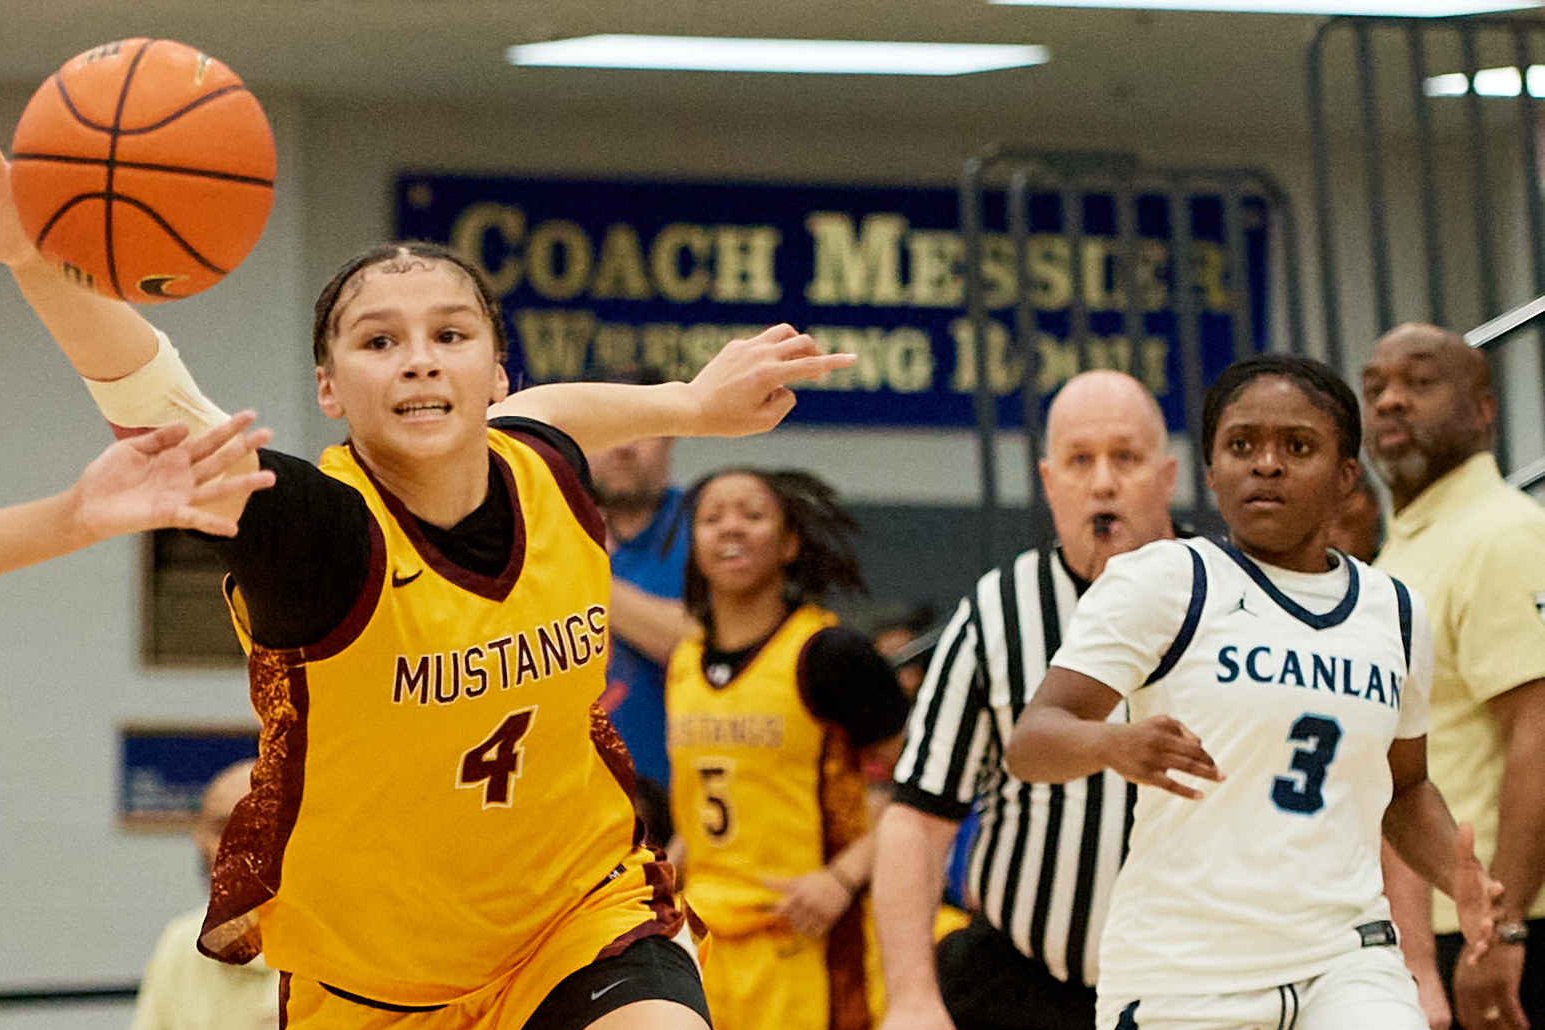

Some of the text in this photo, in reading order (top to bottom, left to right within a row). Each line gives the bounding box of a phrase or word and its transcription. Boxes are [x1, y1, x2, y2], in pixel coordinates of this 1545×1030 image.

[392, 605, 607, 707] MUSTANGS
[1215, 645, 1403, 713] SCANLAN
[455, 704, 538, 810] 4
[693, 757, 738, 846] 5
[1269, 711, 1344, 818] 3
